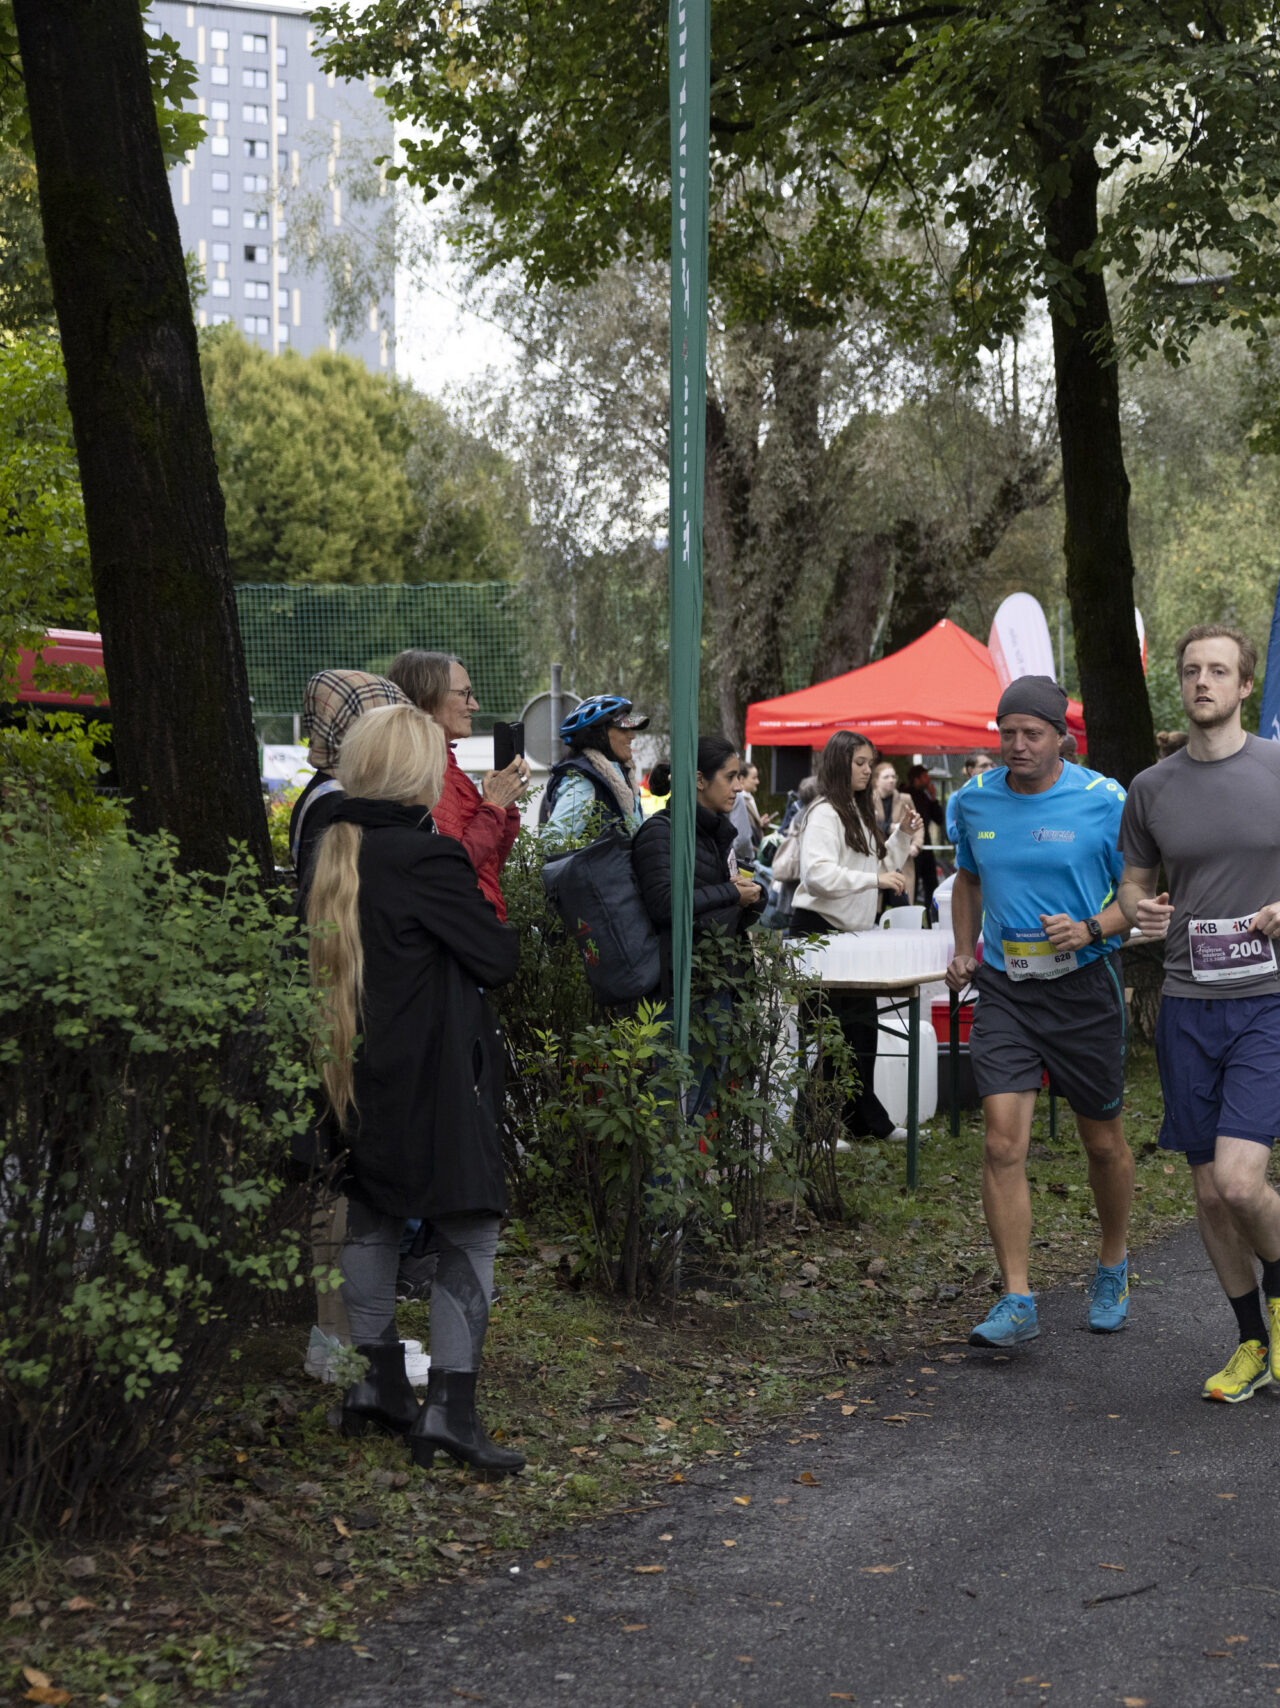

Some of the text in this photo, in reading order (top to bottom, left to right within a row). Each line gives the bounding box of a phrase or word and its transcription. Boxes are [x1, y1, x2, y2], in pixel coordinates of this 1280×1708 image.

[977, 831, 996, 840] JAKO
[1195, 922, 1218, 934] iKB
[1229, 939, 1262, 959] 200
[1054, 952, 1072, 963] 628
